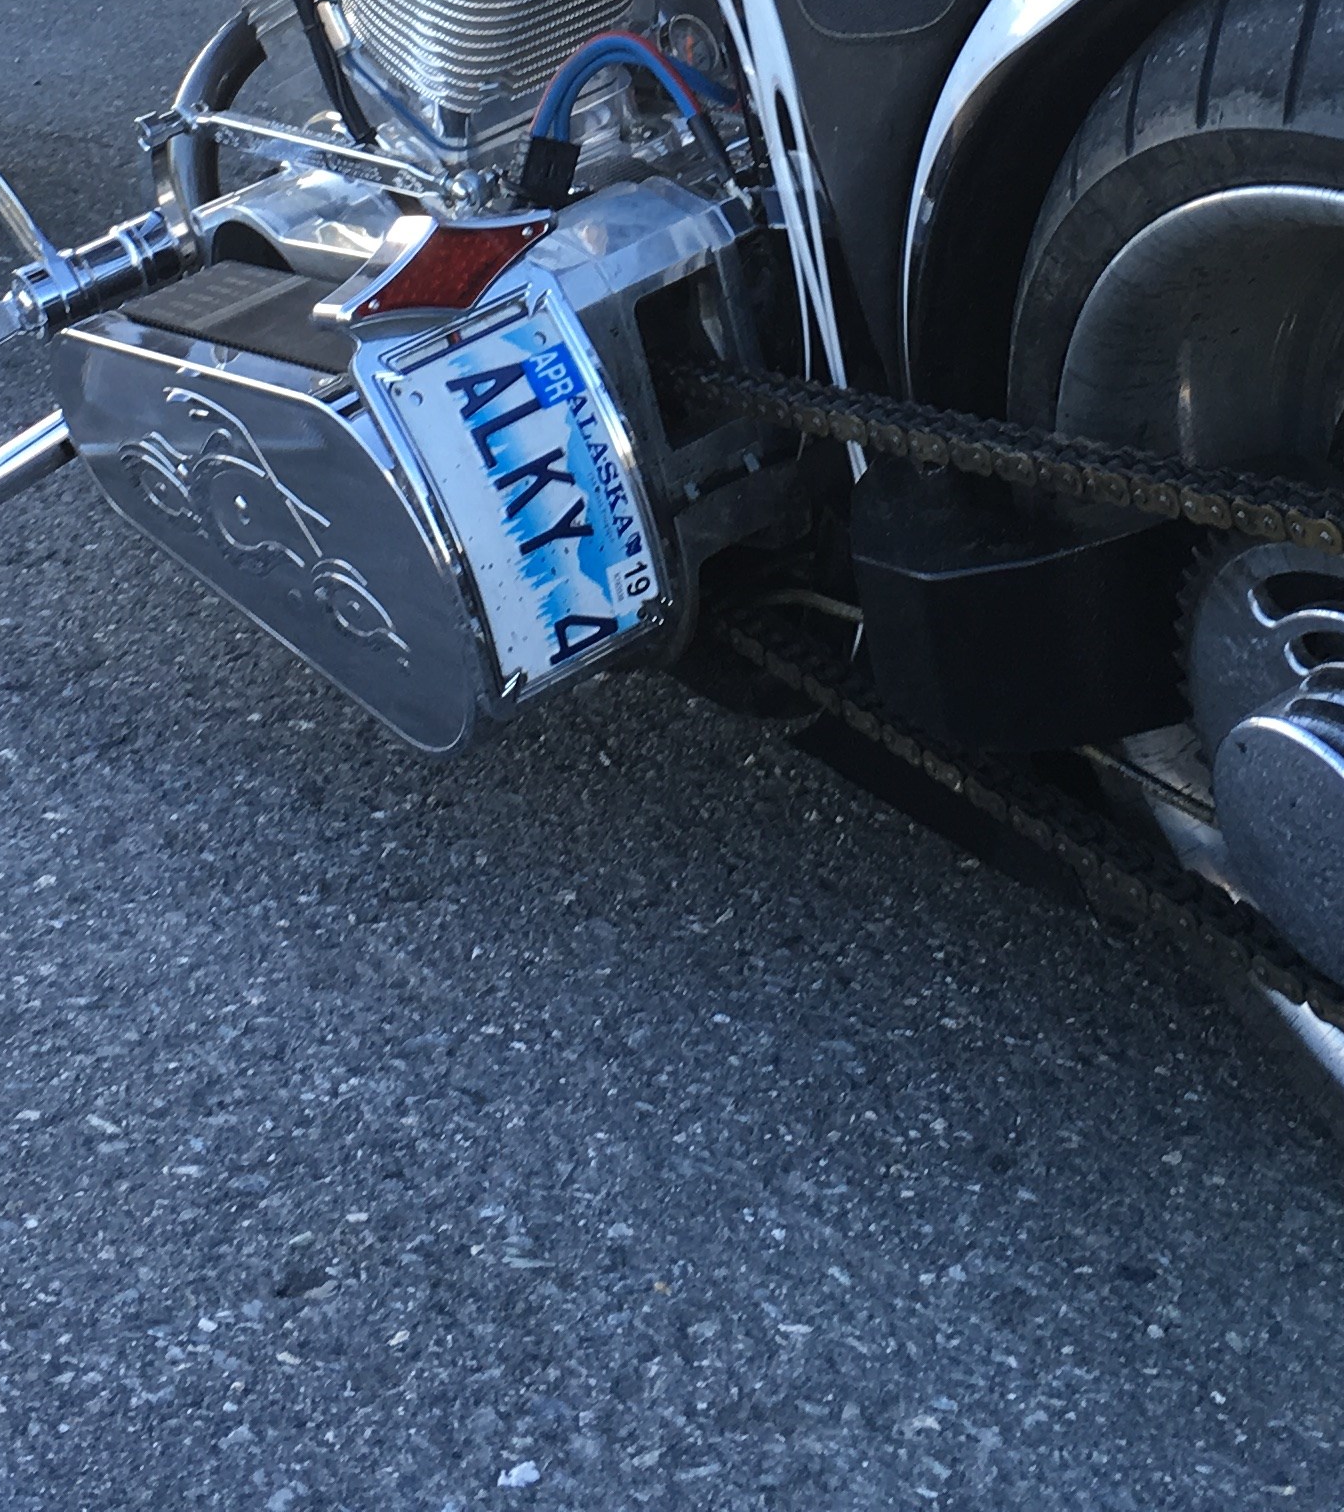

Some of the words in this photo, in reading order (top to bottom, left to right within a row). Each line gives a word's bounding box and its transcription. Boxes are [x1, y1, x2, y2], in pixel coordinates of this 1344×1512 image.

[528, 350, 575, 407] APR
[446, 362, 594, 555] ALKY
[549, 614, 619, 665] 4
[566, 392, 635, 539] ALASKA
[623, 561, 651, 597] 19
